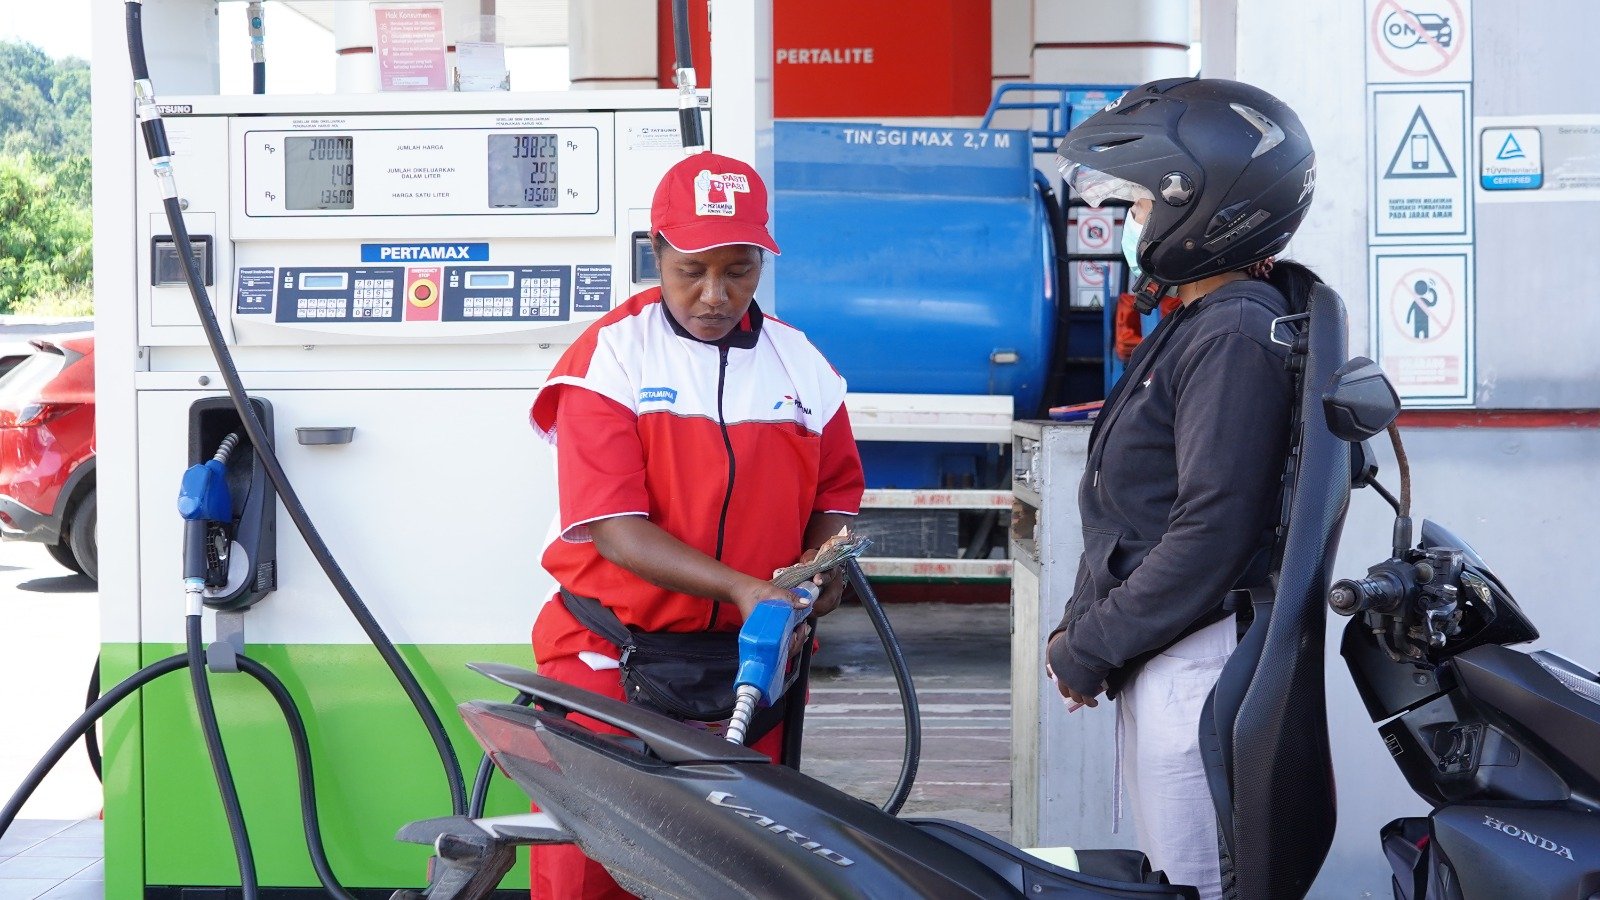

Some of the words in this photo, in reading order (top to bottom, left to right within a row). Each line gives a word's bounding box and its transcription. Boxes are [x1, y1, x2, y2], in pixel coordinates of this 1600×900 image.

[1389, 24, 1416, 36] ON
[776, 48, 874, 64] PERTALITE
[308, 138, 353, 160] 20000
[512, 136, 556, 158] 39825
[911, 132, 954, 147] MAX
[963, 132, 989, 150] 2,7
[994, 133, 1010, 148] M
[530, 162, 556, 185] 2,95
[1493, 176, 1532, 184] CERTIFIED
[321, 190, 353, 203] 13500
[524, 188, 556, 201] 13500
[381, 246, 470, 259] PERTAMAX
[640, 390, 674, 400] ERTAMINA
[706, 790, 855, 867] VARIO
[1482, 814, 1575, 862] HONDA
